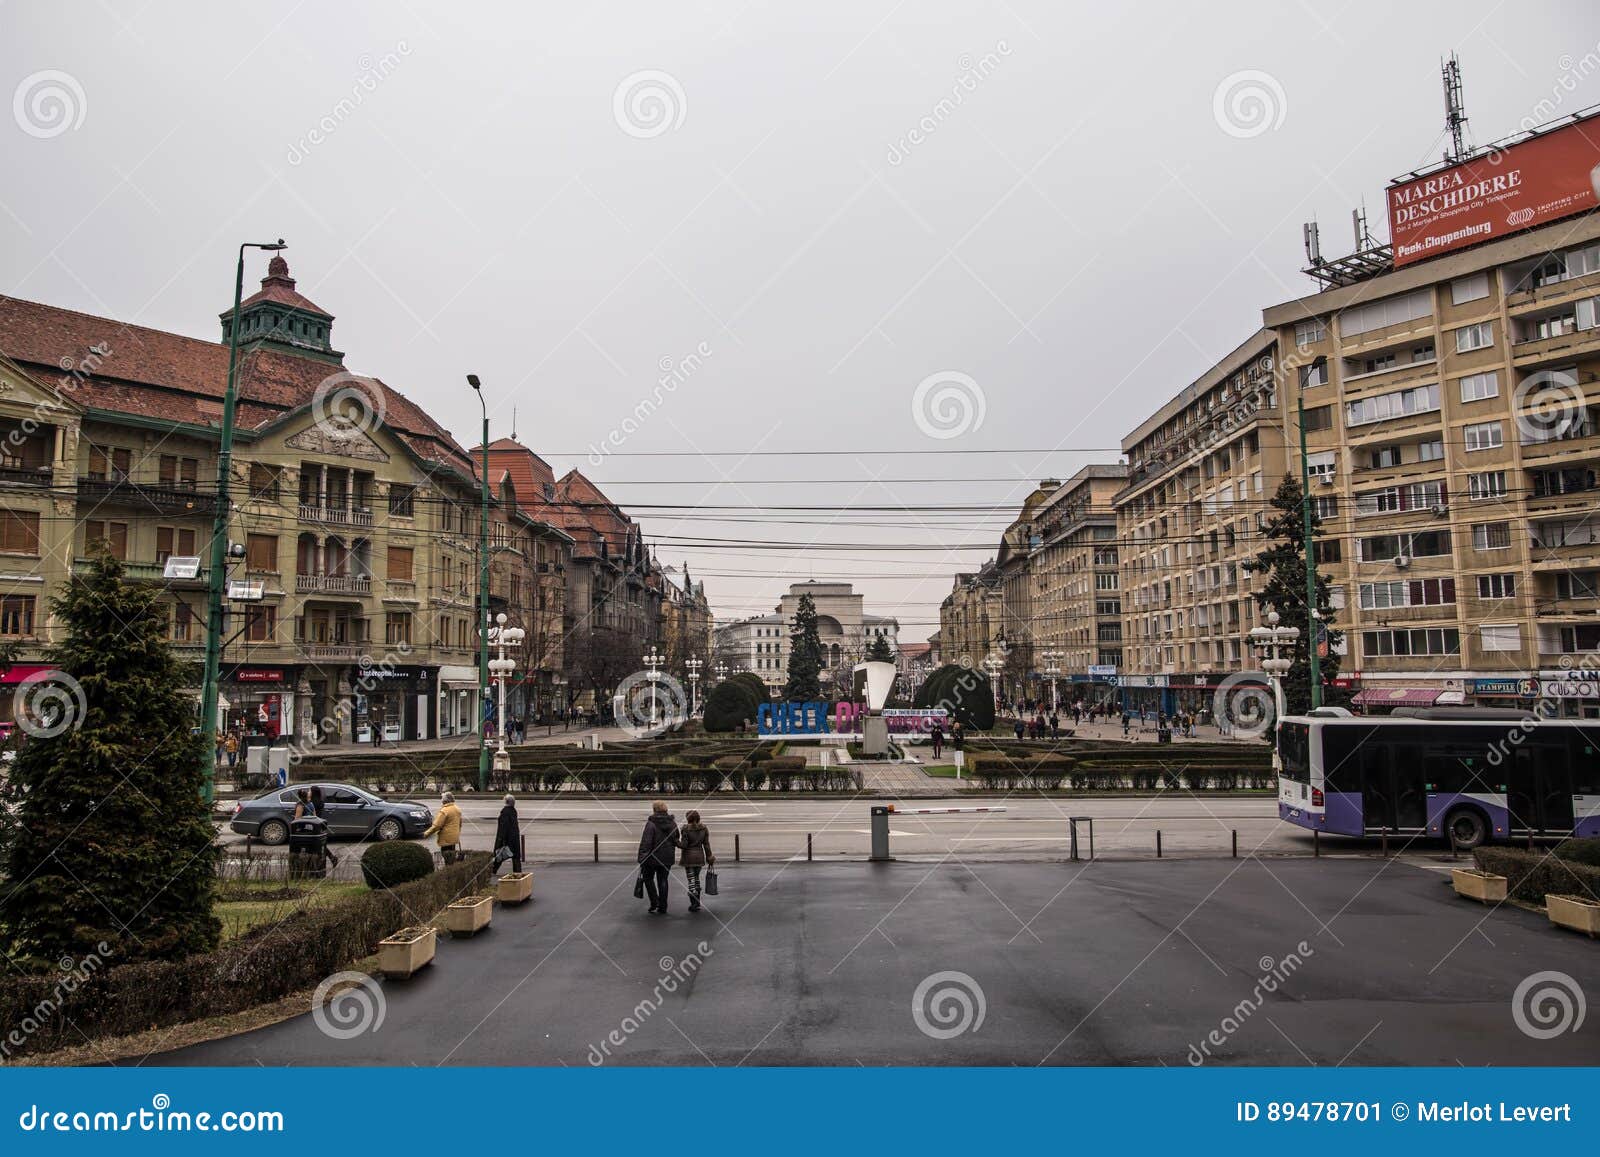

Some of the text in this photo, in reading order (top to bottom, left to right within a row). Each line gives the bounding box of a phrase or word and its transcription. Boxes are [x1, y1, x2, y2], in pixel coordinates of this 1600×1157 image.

[1394, 171, 1464, 207] MAREA
[1395, 169, 1522, 225] DESCHIDERE
[1439, 205, 1470, 219] Shopping
[1471, 200, 1485, 209] City
[758, 701, 830, 735] CHECK
